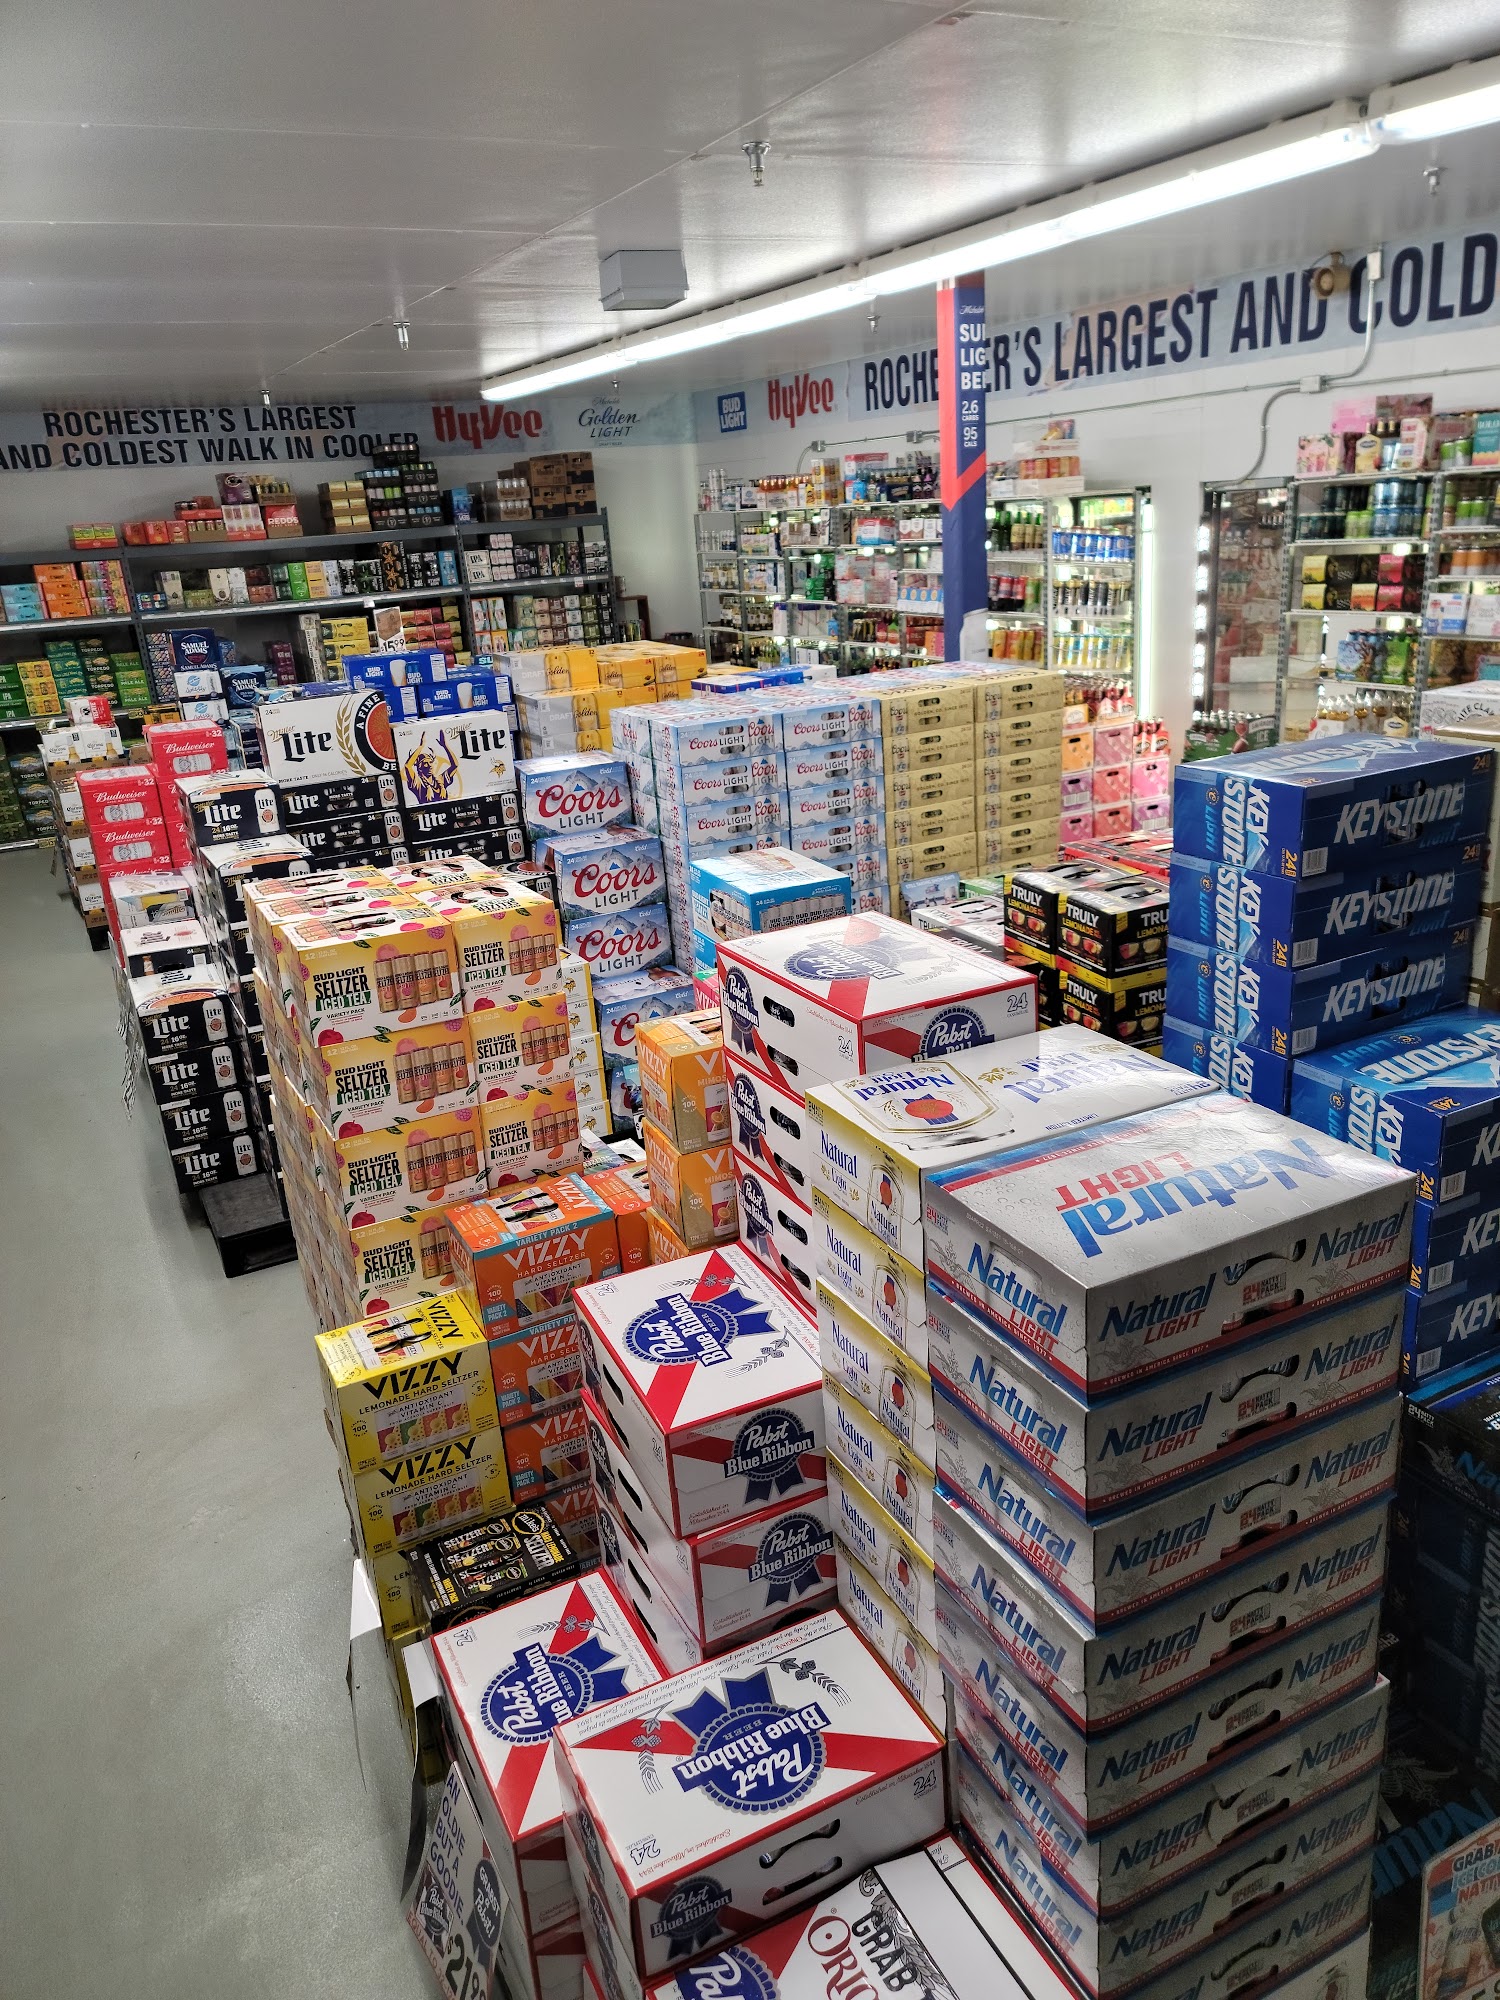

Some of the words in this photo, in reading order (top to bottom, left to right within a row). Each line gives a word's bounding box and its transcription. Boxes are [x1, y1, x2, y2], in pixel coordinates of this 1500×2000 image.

[864, 326, 1041, 412] ROCHER'S
[1054, 287, 1218, 382] LARGEST
[1230, 268, 1328, 353] AND
[1349, 233, 1498, 334] COLD
[722, 397, 741, 412] BUD
[961, 400, 979, 414] 2.6
[44, 407, 236, 438] ROCHESTER'S
[245, 405, 357, 432] LARGEST
[578, 406, 641, 427] Golden
[720, 411, 745, 429] LIGHT
[590, 426, 633, 438] LIGHT
[963, 427, 978, 440] 95
[63, 439, 190, 468] COLDEST
[197, 436, 278, 463] WALK
[286, 435, 314, 460] IN
[267, 516, 299, 525] REDD'S
[470, 555, 483, 564] IPA
[472, 571, 485, 580] IPA
[181, 641, 209, 650] SAMUEL
[184, 647, 208, 655] ADAMS
[231, 677, 259, 687] SAMUEL
[521, 670, 545, 679] DRAFT
[546, 665, 570, 676] Golden
[6, 710, 15, 718] IPA
[358, 693, 382, 720] FINE
[574, 707, 599, 719] Golden
[266, 725, 296, 743] Miller
[356, 720, 365, 729] A
[445, 722, 473, 740] Miller
[794, 723, 820, 735] Coors
[821, 720, 846, 731] LIGHT
[163, 742, 215, 754] Budweiser
[281, 729, 333, 763] Lite
[459, 727, 507, 760] Lite
[689, 738, 718, 750] Coors
[719, 735, 745, 746] LIGHT
[1256, 731, 1269, 742] ICE
[143, 778, 155, 786] 32
[380, 778, 394, 788] Lite
[693, 779, 722, 790] Coors
[723, 775, 748, 786] LIGHT
[93, 790, 148, 802] Budweiser
[257, 798, 274, 809] Lite
[288, 794, 320, 814] Lite
[536, 784, 623, 818] Coors
[800, 800, 827, 812] Coors
[827, 797, 851, 807] LIGHT
[151, 817, 163, 825] 32
[203, 803, 242, 827] Lite
[417, 812, 447, 831] Lite
[559, 811, 605, 829] LIGHT
[1221, 776, 1248, 867] STONE
[1247, 786, 1270, 846] KEY
[1333, 778, 1466, 845] KEYSTONE
[102, 830, 156, 843] Budweiser
[1204, 805, 1218, 852] LIGHT
[572, 862, 658, 898] Coors
[594, 889, 640, 908] LIGHT
[1007, 898, 1039, 915] LEMONADE
[1011, 884, 1043, 907] TRULY
[1065, 903, 1099, 927] TRULY
[1062, 918, 1095, 936] LEMONADE
[313, 969, 336, 982] BUD
[336, 966, 365, 979] LIGHT
[314, 974, 370, 1001] SELTZER
[1321, 953, 1446, 1023] KEYSTONE
[318, 997, 343, 1011] ICED
[344, 991, 369, 1007] TEA
[1006, 992, 1028, 1012] 24
[326, 1009, 350, 1019] VARIETY
[350, 1007, 365, 1015] PACK
[151, 1015, 190, 1039] Lite
[932, 1019, 973, 1048] Pabst
[215, 1054, 231, 1065] Lite
[161, 1062, 199, 1086] Lite
[853, 1071, 956, 1102] Natural
[183, 1152, 221, 1175] Lite
[820, 1129, 858, 1179] Natural
[1056, 1150, 1193, 1211] LIGHT
[1059, 1137, 1338, 1258] Natural
[515, 1232, 549, 1247] VARIETY
[550, 1225, 571, 1237] PACK
[1311, 1201, 1409, 1267] Natural
[503, 1232, 592, 1270] VIZZY
[1346, 1235, 1400, 1269] LIGHT
[517, 1266, 543, 1278] HARD
[547, 1252, 586, 1268] SELTZER
[968, 1242, 1068, 1337] Natural
[1242, 1281, 1261, 1301] 24
[1316, 1295, 1336, 1306] BREWED
[1348, 1282, 1368, 1294] AMERICA
[1369, 1277, 1384, 1286] SINCE
[667, 1294, 708, 1338] Ribbon
[1100, 1272, 1216, 1342] Natural
[1010, 1307, 1059, 1355] LIGHT
[1143, 1309, 1206, 1345] LIGHT
[641, 1319, 688, 1359] Pabst
[696, 1335, 729, 1365] Blue
[363, 1351, 465, 1400] VIZZY
[359, 1393, 411, 1415] LEMONADE
[413, 1384, 439, 1400] HARD
[442, 1370, 479, 1388] SELTZER
[399, 1390, 454, 1412] ANTIOXIDANT
[352, 1424, 367, 1433] 100
[743, 1420, 789, 1452] Pabst
[726, 1450, 762, 1478] Blue
[761, 1435, 813, 1469] Ribbon
[497, 1680, 543, 1738] Pabst
[722, 1719, 764, 1739] BEER
[764, 1704, 826, 1739] Blue
[679, 1726, 764, 1779] Ribbon
[732, 1741, 814, 1798] Pabst
[446, 1773, 461, 1806] AN
[442, 1796, 466, 1856] OLDIE
[436, 1817, 455, 1859] BUT
[452, 1859, 460, 1877] A
[630, 1838, 661, 1866] 24
[1453, 1842, 1493, 1873] GRAB
